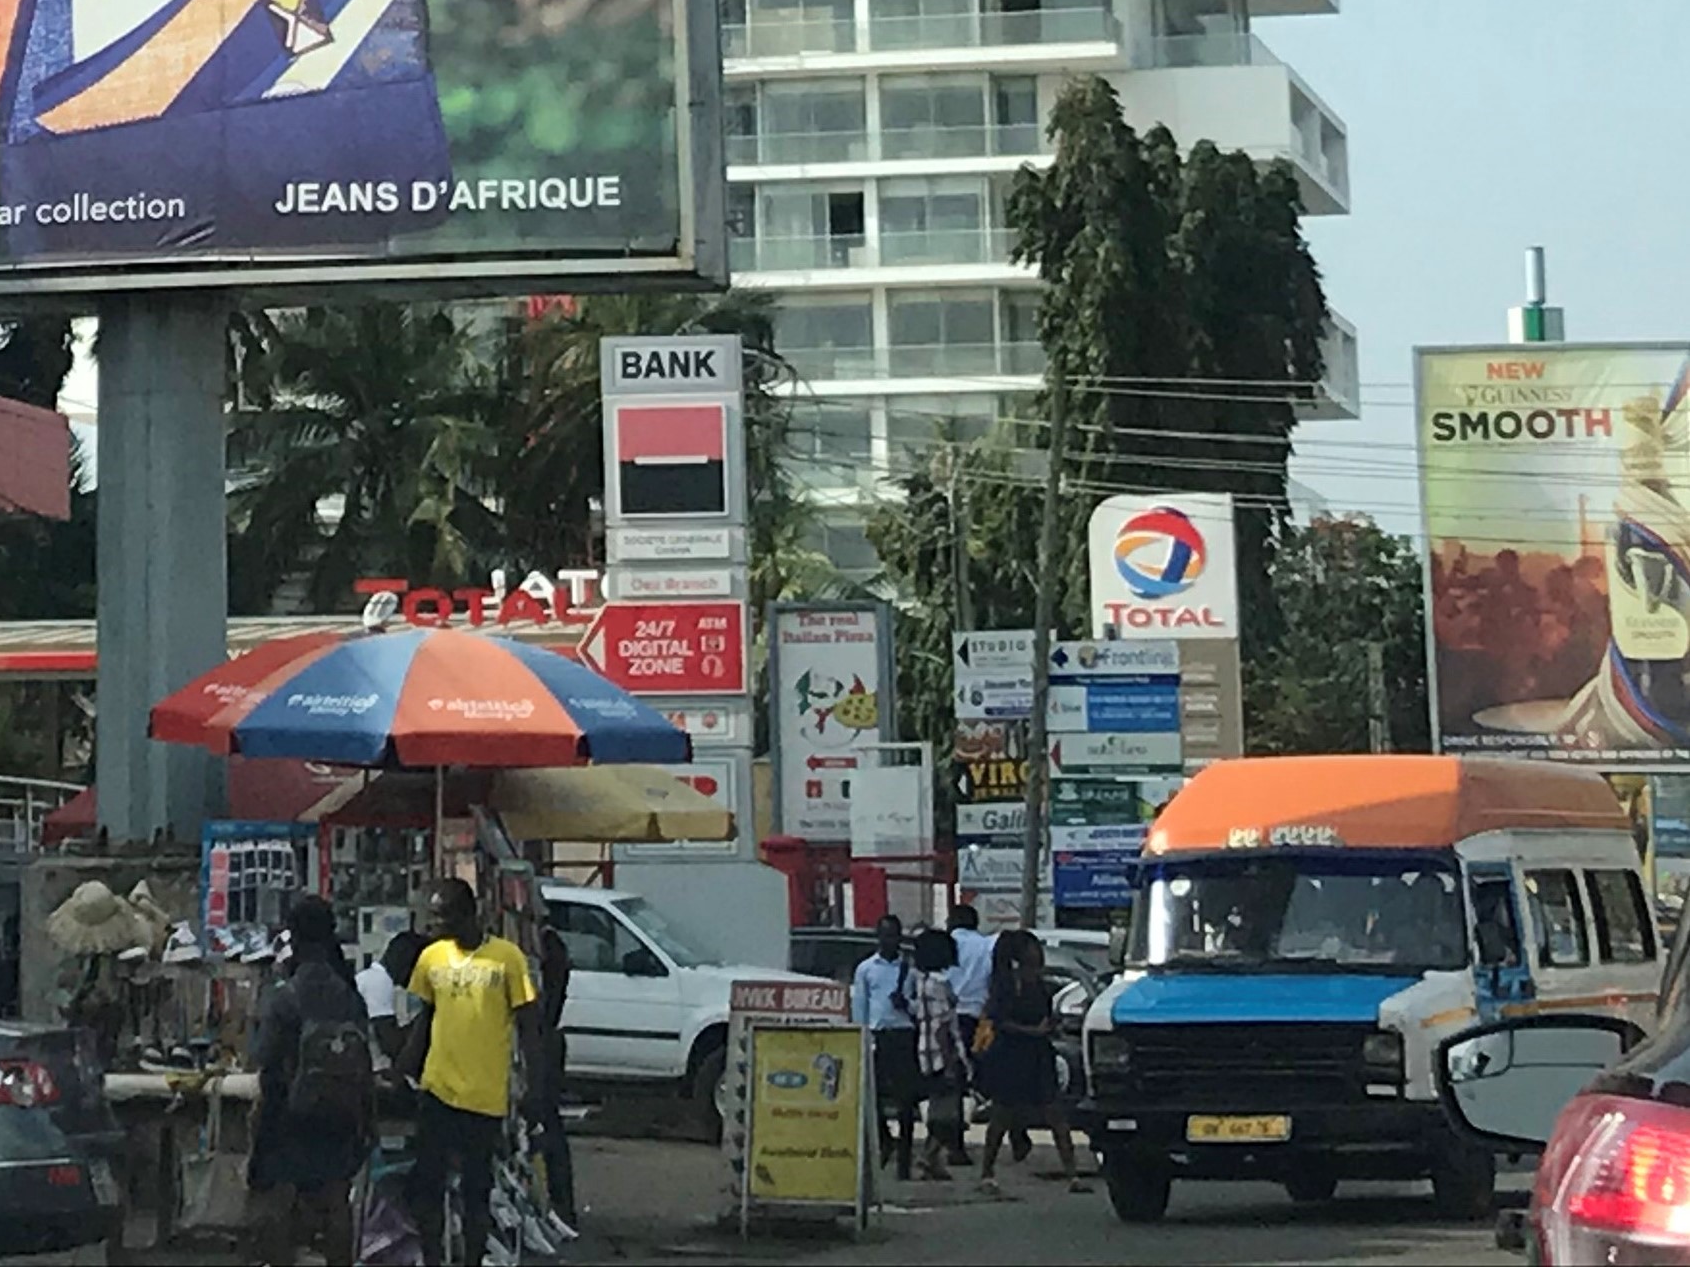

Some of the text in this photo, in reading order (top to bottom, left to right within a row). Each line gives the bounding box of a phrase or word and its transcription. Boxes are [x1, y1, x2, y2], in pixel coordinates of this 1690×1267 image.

[275, 175, 621, 214] JEANS D'AFRIQUE
[35, 191, 186, 225] collection
[620, 349, 718, 381] BANK
[1486, 362, 1546, 380] NEW
[1481, 385, 1573, 405] GUINNESS
[1432, 408, 1613, 441] SMOOTH
[1104, 602, 1225, 628] TOTAL
[634, 617, 728, 638] 24/7 ATM
[618, 639, 695, 658] DIGITAL
[627, 657, 686, 677] ZONE
